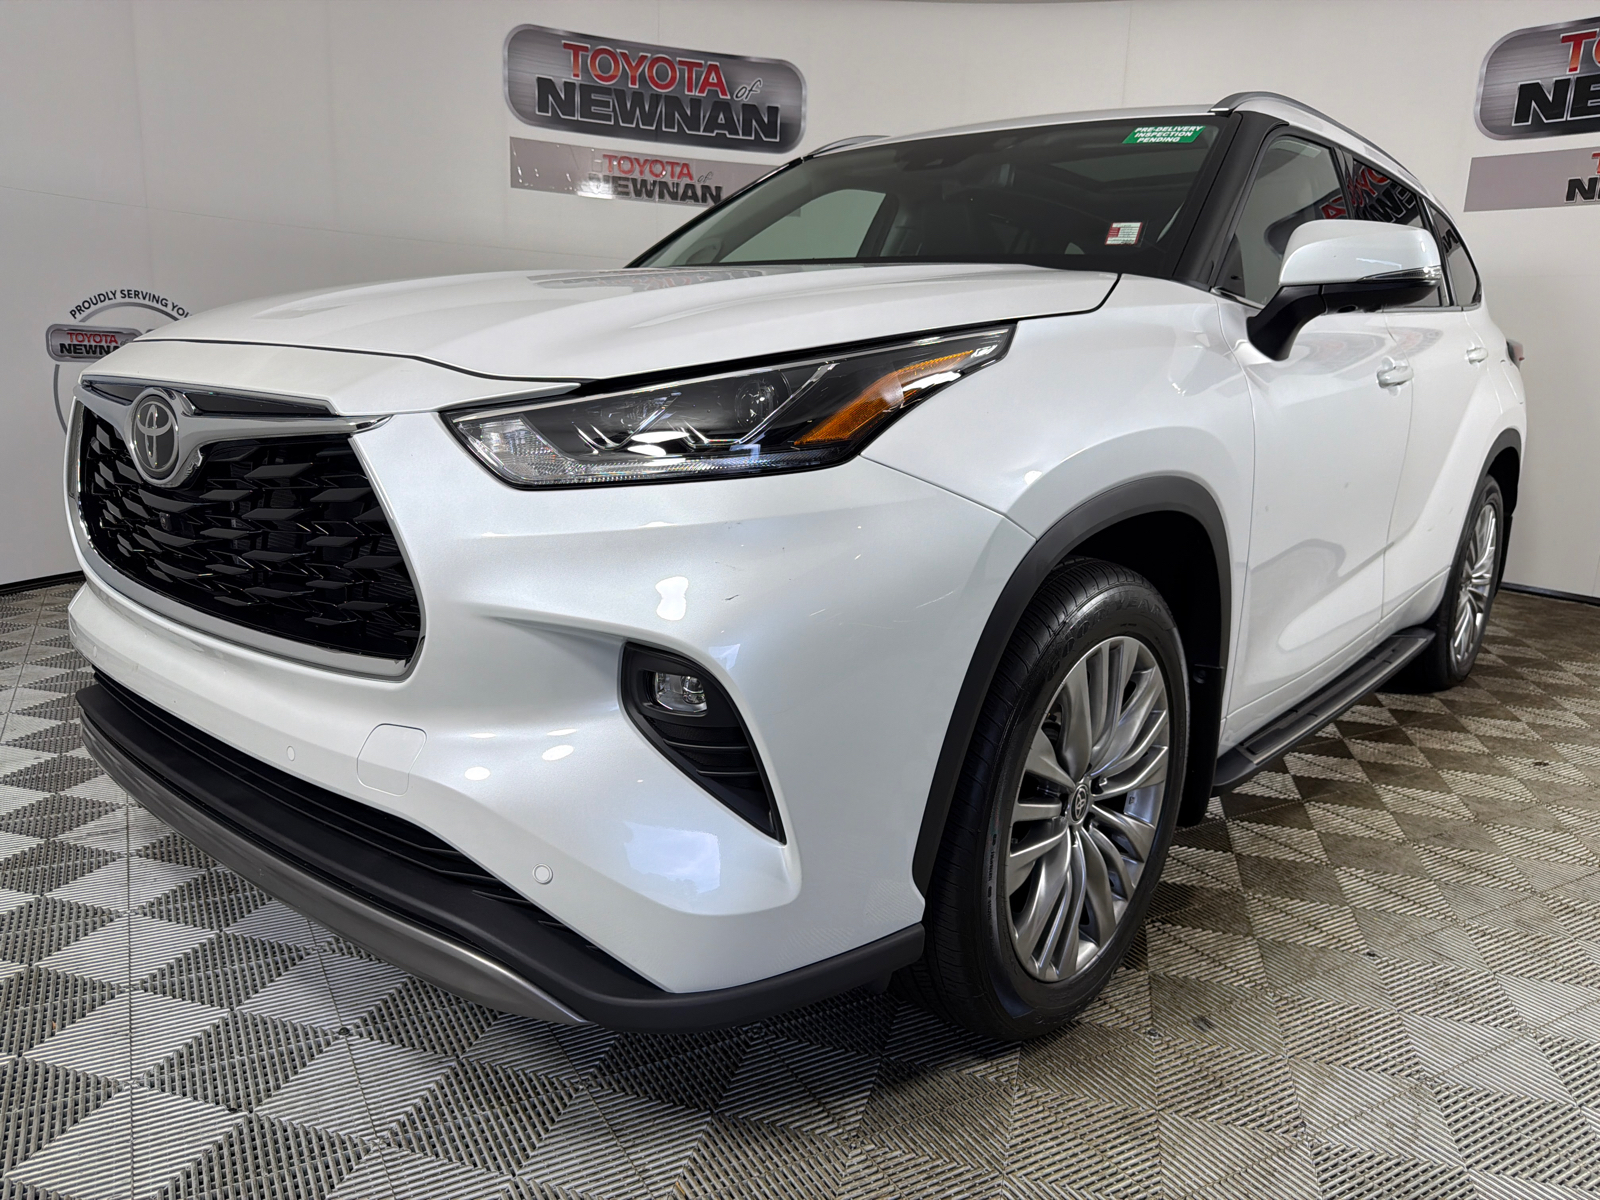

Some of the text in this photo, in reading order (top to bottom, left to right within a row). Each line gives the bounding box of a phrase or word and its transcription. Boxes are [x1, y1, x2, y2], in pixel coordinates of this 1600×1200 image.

[1560, 28, 1600, 74] T
[562, 40, 763, 101] TOYOTA of
[535, 75, 780, 142] NEWNAN
[602, 153, 714, 183] TOYOTA of
[1564, 175, 1600, 202] N
[69, 289, 118, 319] PROUDLY
[120, 289, 169, 308] SERVING
[66, 331, 119, 345] TOYOTA
